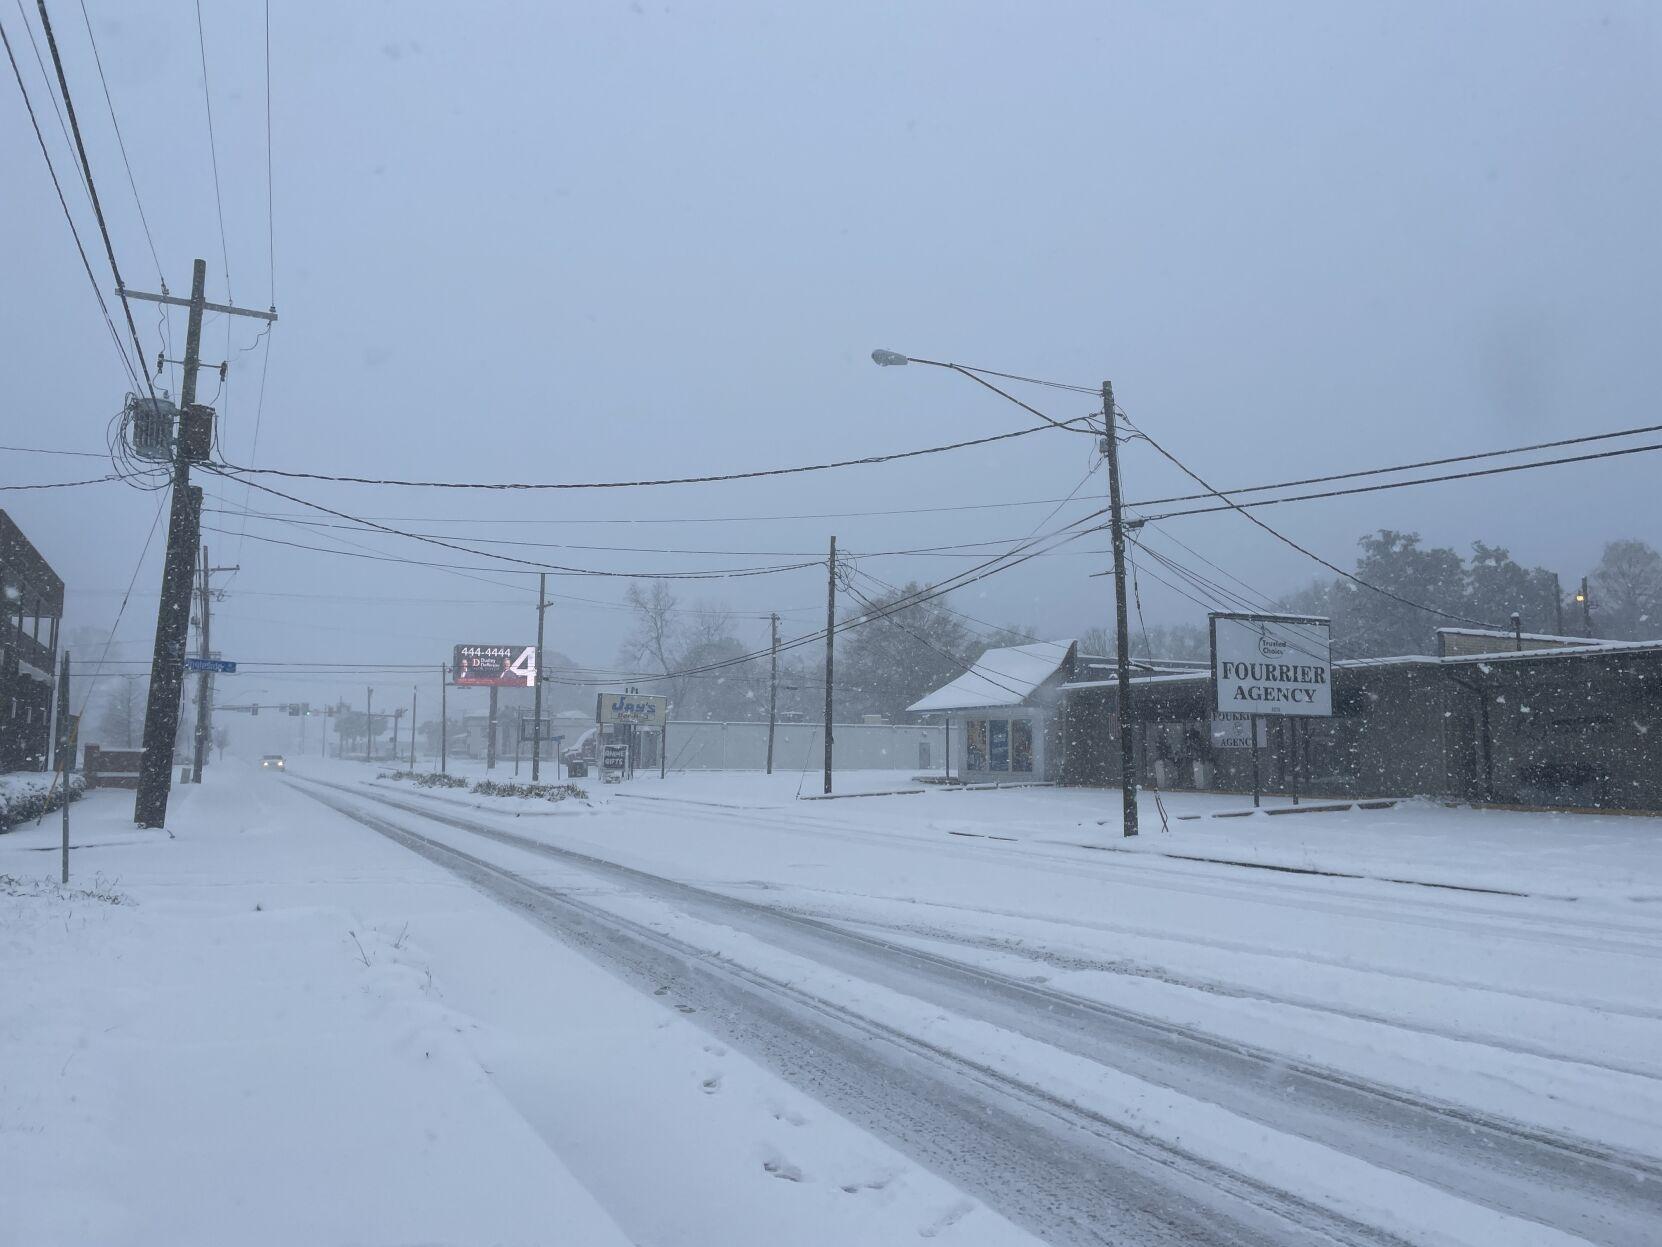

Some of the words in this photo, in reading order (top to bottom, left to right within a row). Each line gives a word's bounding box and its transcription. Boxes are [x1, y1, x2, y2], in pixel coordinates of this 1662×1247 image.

[1262, 639, 1287, 648] Trusted
[461, 647, 511, 657] 444-4444
[510, 646, 537, 687] 4
[1221, 661, 1326, 684] FOURRIER
[1233, 685, 1317, 703] AGENCY
[1221, 738, 1252, 747] AGENC
